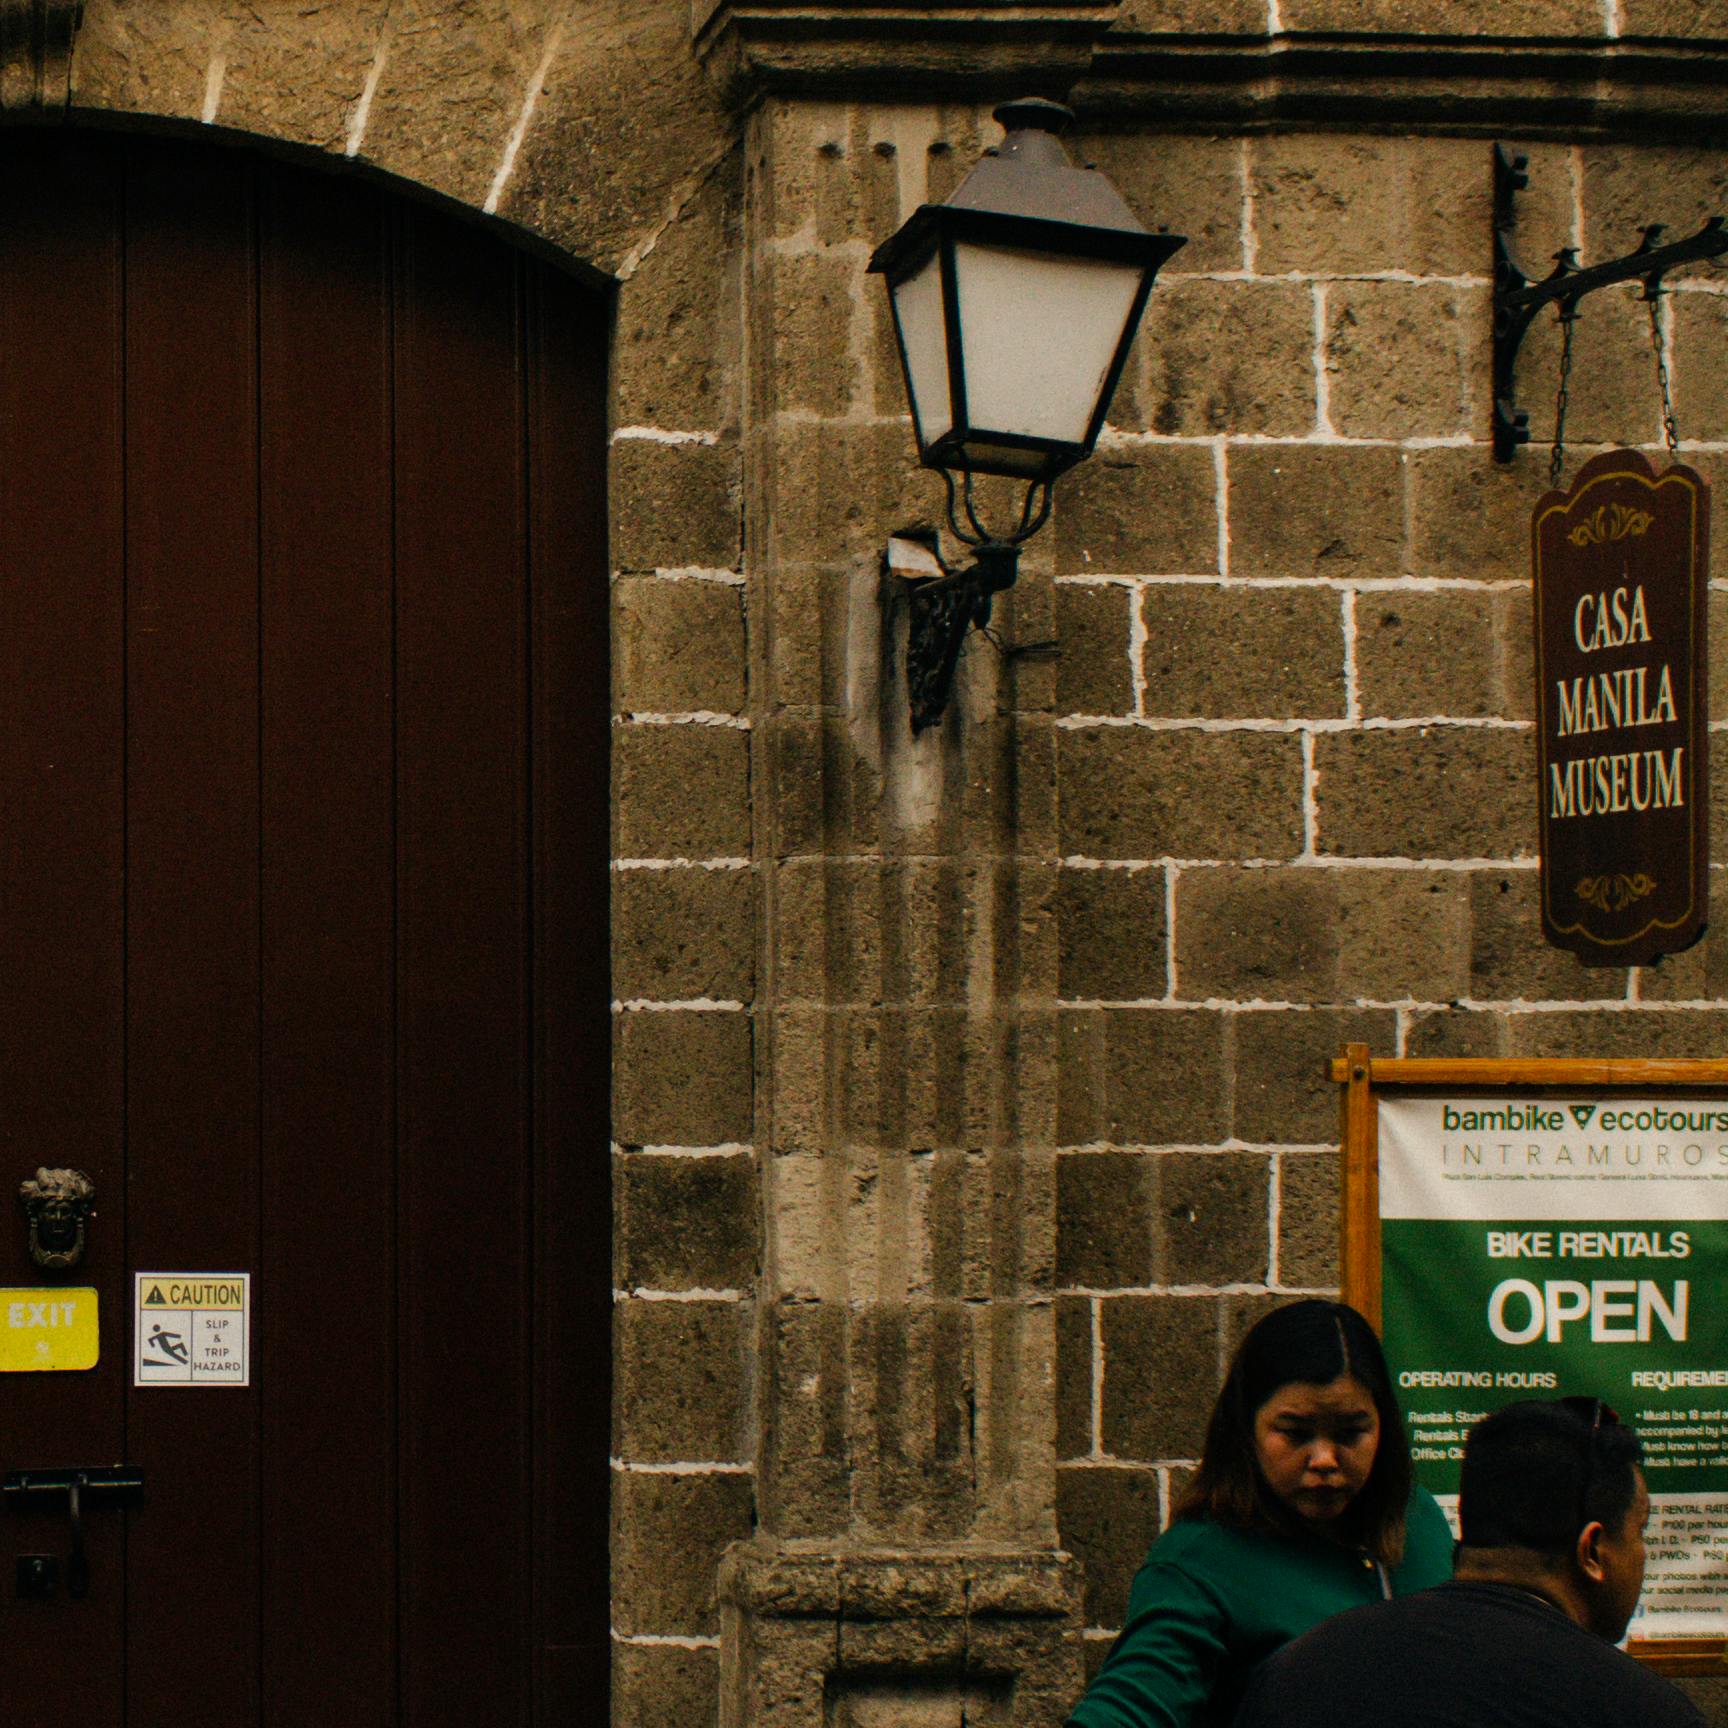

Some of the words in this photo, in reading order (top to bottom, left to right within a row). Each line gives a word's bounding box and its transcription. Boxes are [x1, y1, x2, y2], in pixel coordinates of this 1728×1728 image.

[1574, 584, 1652, 654] CASA
[1556, 663, 1679, 738] MANILA
[1549, 747, 1685, 819] MUSEUM
[1442, 1104, 1565, 1132] bambike
[1599, 1106, 1728, 1132] ecotours
[1442, 1143, 1728, 1166] INTRAMUROS
[1487, 1231, 1553, 1258] BIKE
[1559, 1231, 1691, 1258] RENTALS
[170, 1284, 241, 1305] CAUTION
[8, 1302, 76, 1328] EXIT
[1488, 1278, 1689, 1344] OPEN
[205, 1320, 229, 1329] SLIP
[213, 1334, 222, 1343] &
[204, 1348, 230, 1357] TRIP
[193, 1362, 241, 1371] HAZARD
[1399, 1371, 1493, 1388] OPERATING
[1495, 1372, 1557, 1389] HOURS
